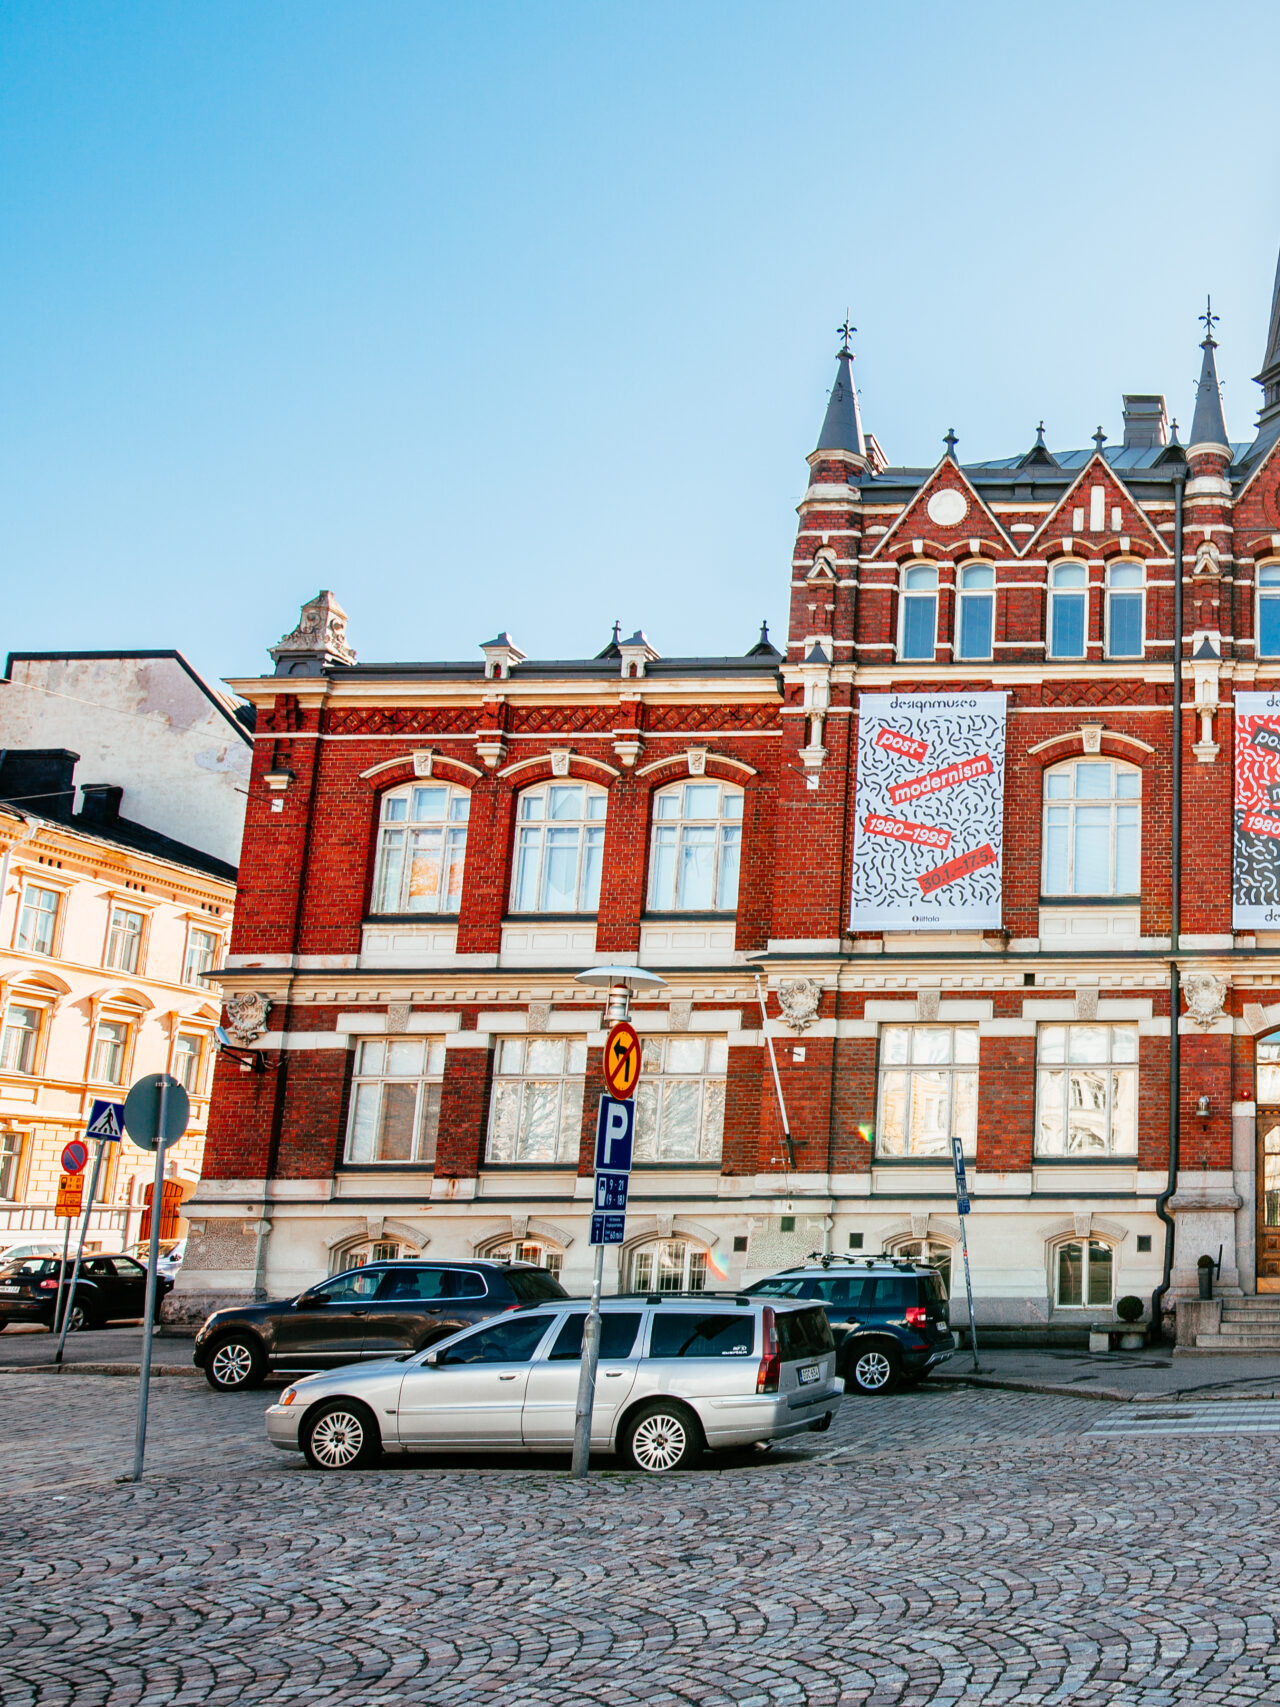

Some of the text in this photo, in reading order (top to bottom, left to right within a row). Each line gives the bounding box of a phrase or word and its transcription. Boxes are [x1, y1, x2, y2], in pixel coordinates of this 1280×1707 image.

[890, 696, 977, 713] designmuseo
[878, 732, 924, 757] post-
[894, 758, 988, 802] modernism
[604, 1102, 628, 1164] P
[955, 1140, 962, 1173] P
[609, 1179, 613, 1191] 9
